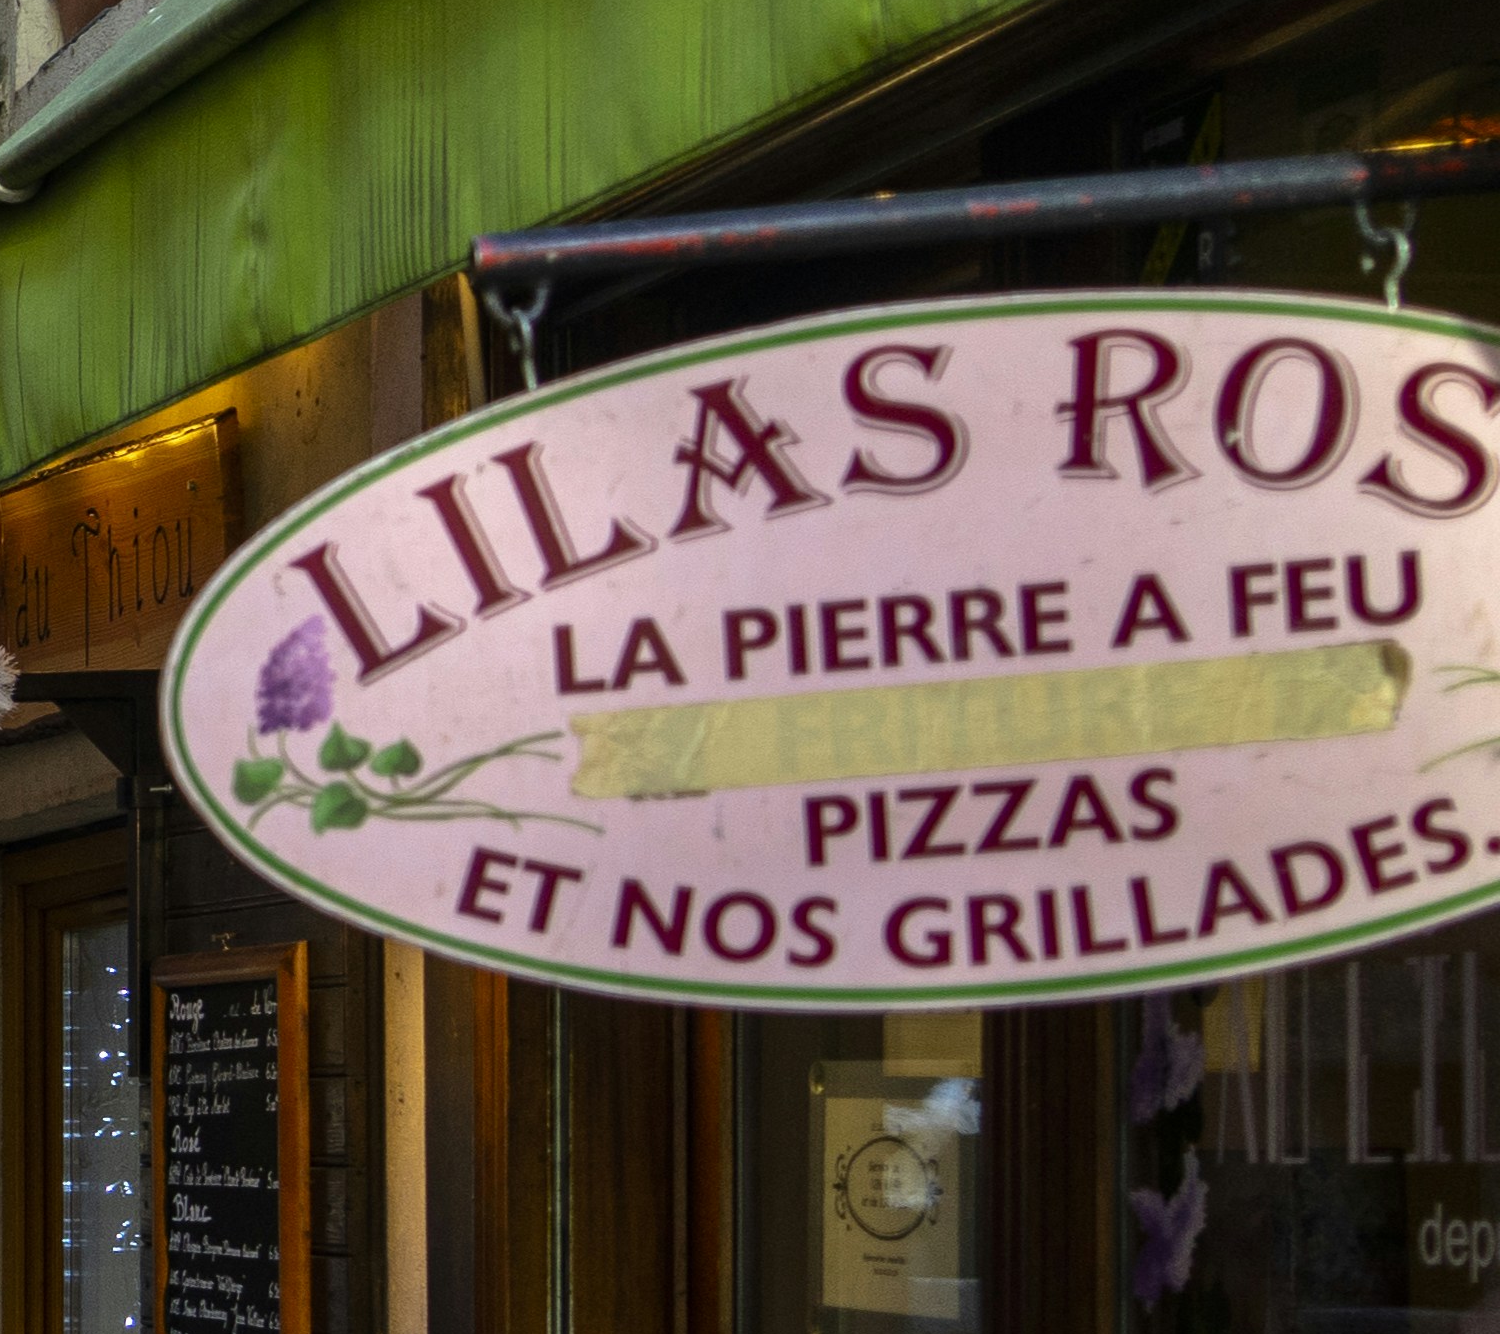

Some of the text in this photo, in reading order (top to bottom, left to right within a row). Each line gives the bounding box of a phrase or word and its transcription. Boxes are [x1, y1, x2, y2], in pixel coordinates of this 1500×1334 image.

[290, 343, 974, 688] LILAS
[14, 554, 51, 648] du
[70, 507, 193, 667] Thiou
[554, 550, 1423, 697] LA PIERRE A FEU
[802, 767, 1181, 866] PIZZAS
[456, 847, 582, 934] ET
[613, 878, 840, 970] NOS
[169, 992, 204, 1034] Rouge
[170, 1124, 202, 1153] Rosé
[171, 1192, 212, 1223] Blanc
[1417, 1202, 1500, 1284] dep
